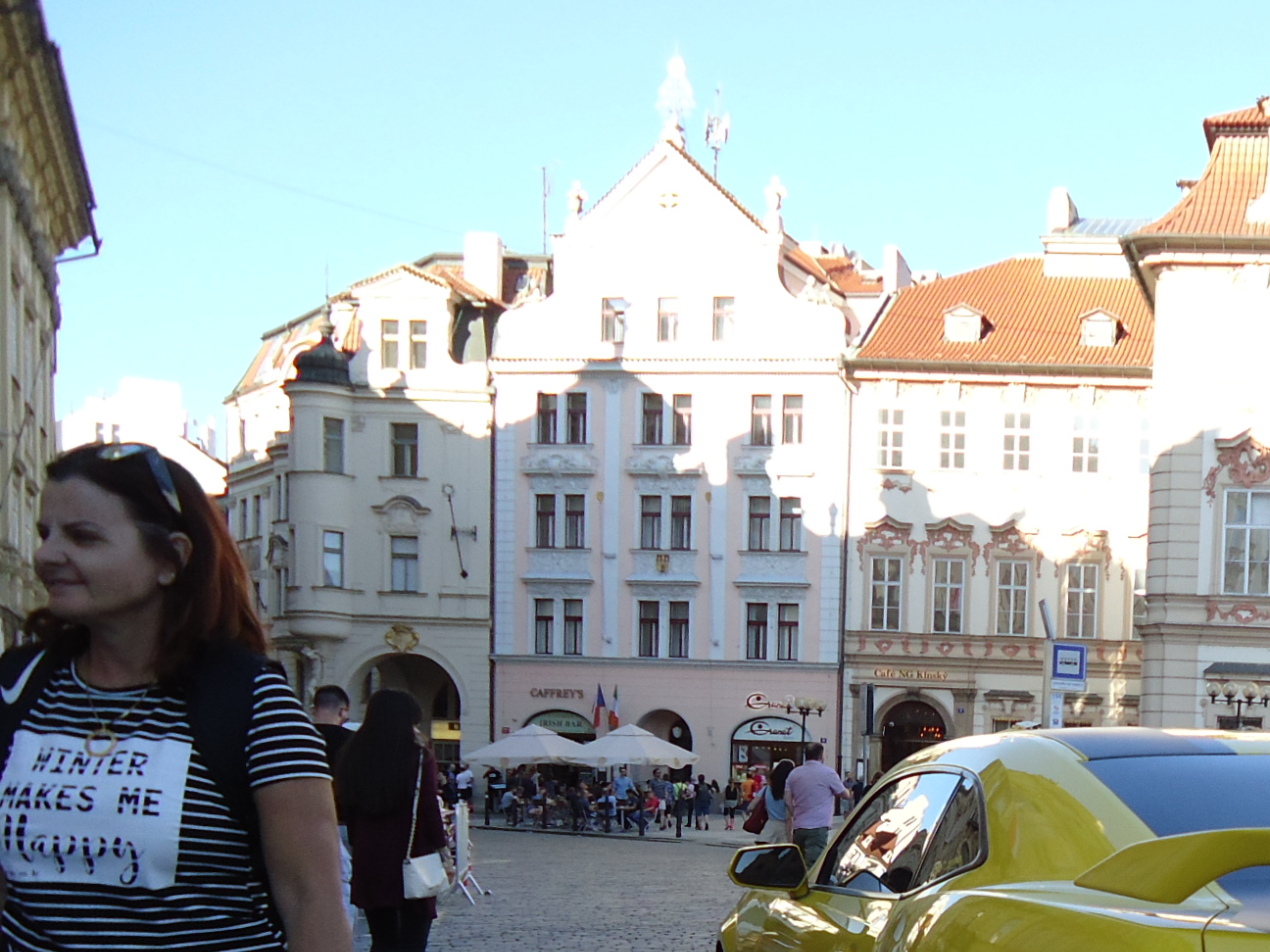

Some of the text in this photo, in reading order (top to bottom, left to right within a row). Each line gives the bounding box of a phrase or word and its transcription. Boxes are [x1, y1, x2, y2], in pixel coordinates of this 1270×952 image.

[529, 688, 584, 699] CAFFREY'S
[539, 719, 562, 727] IRISH
[32, 746, 149, 777] WINTER
[0, 781, 163, 817] MAKES ME
